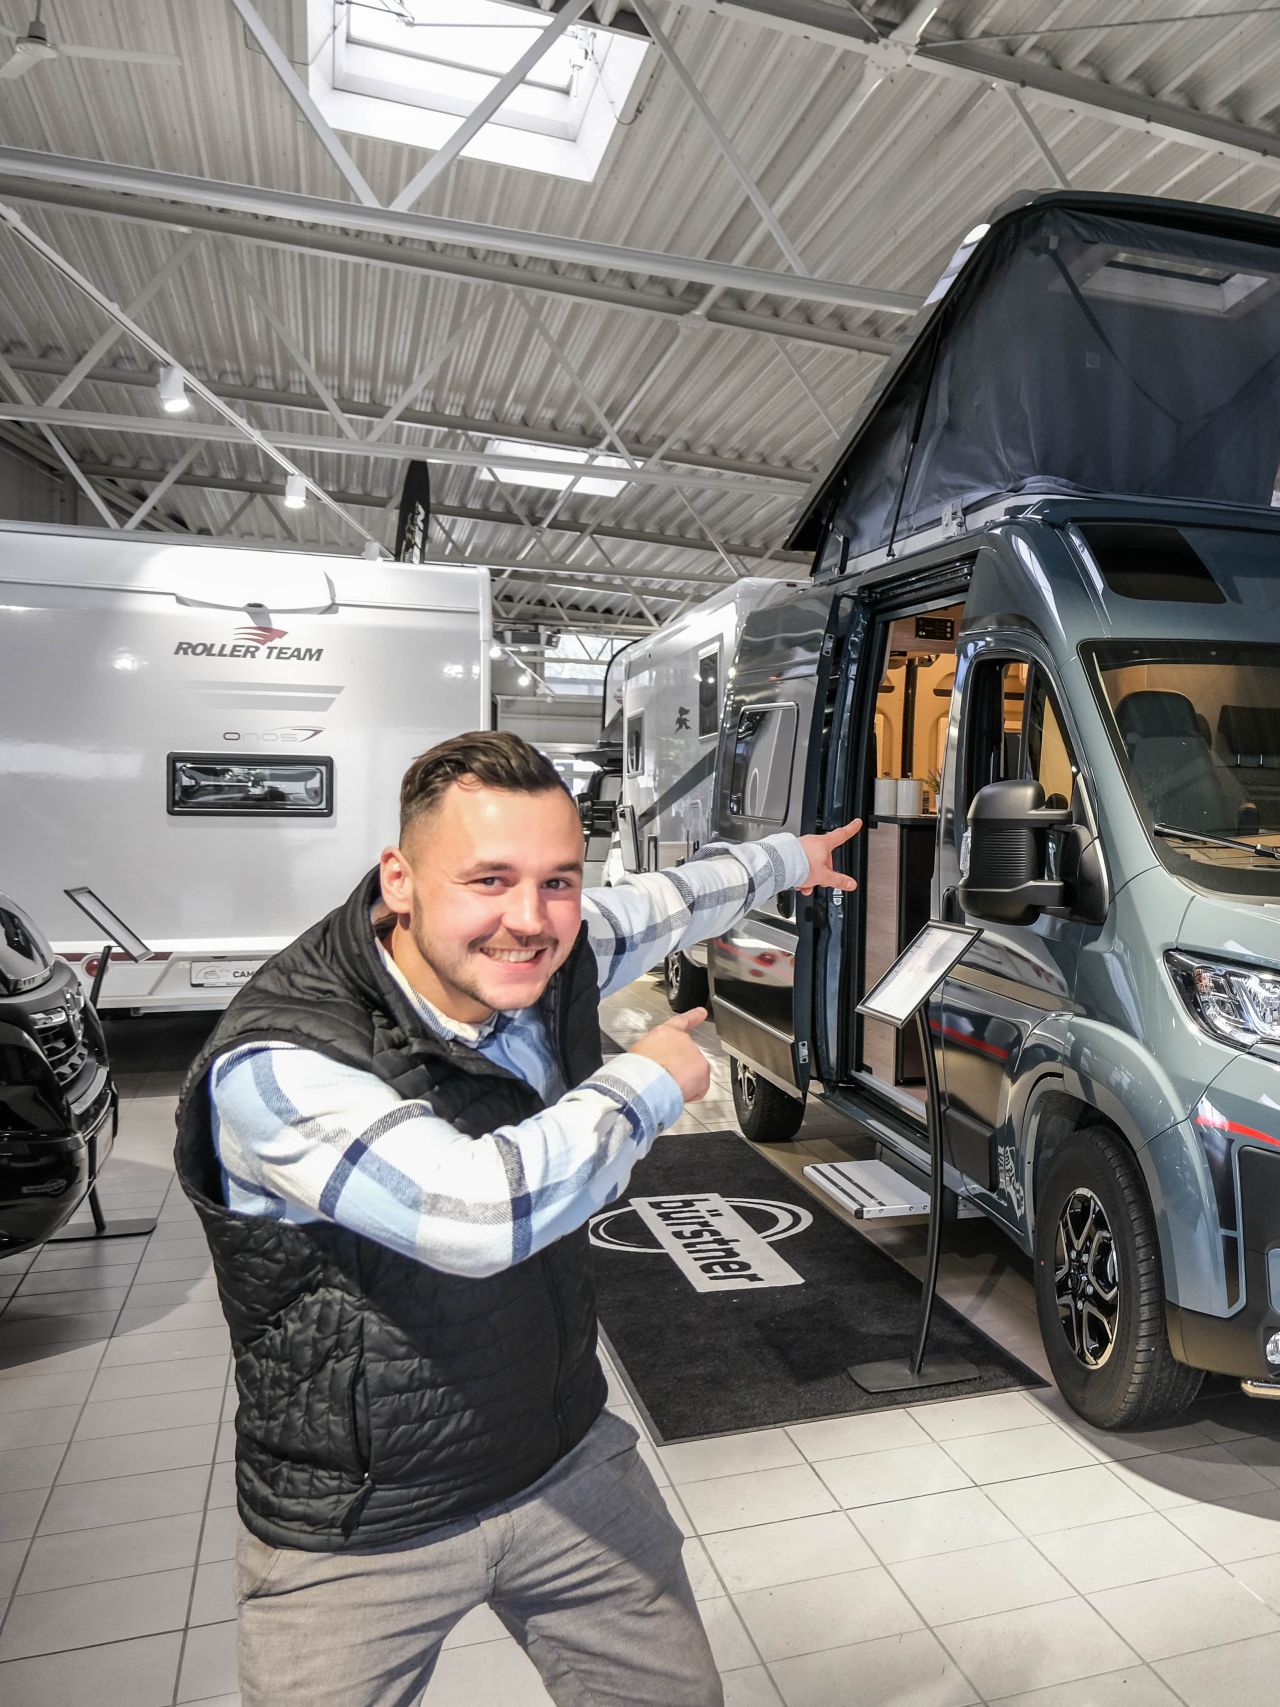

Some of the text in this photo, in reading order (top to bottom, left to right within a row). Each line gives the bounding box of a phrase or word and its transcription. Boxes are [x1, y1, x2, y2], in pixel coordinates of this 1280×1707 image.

[174, 641, 324, 662] ROLLER TEAM
[647, 1198, 765, 1283] bürstner
